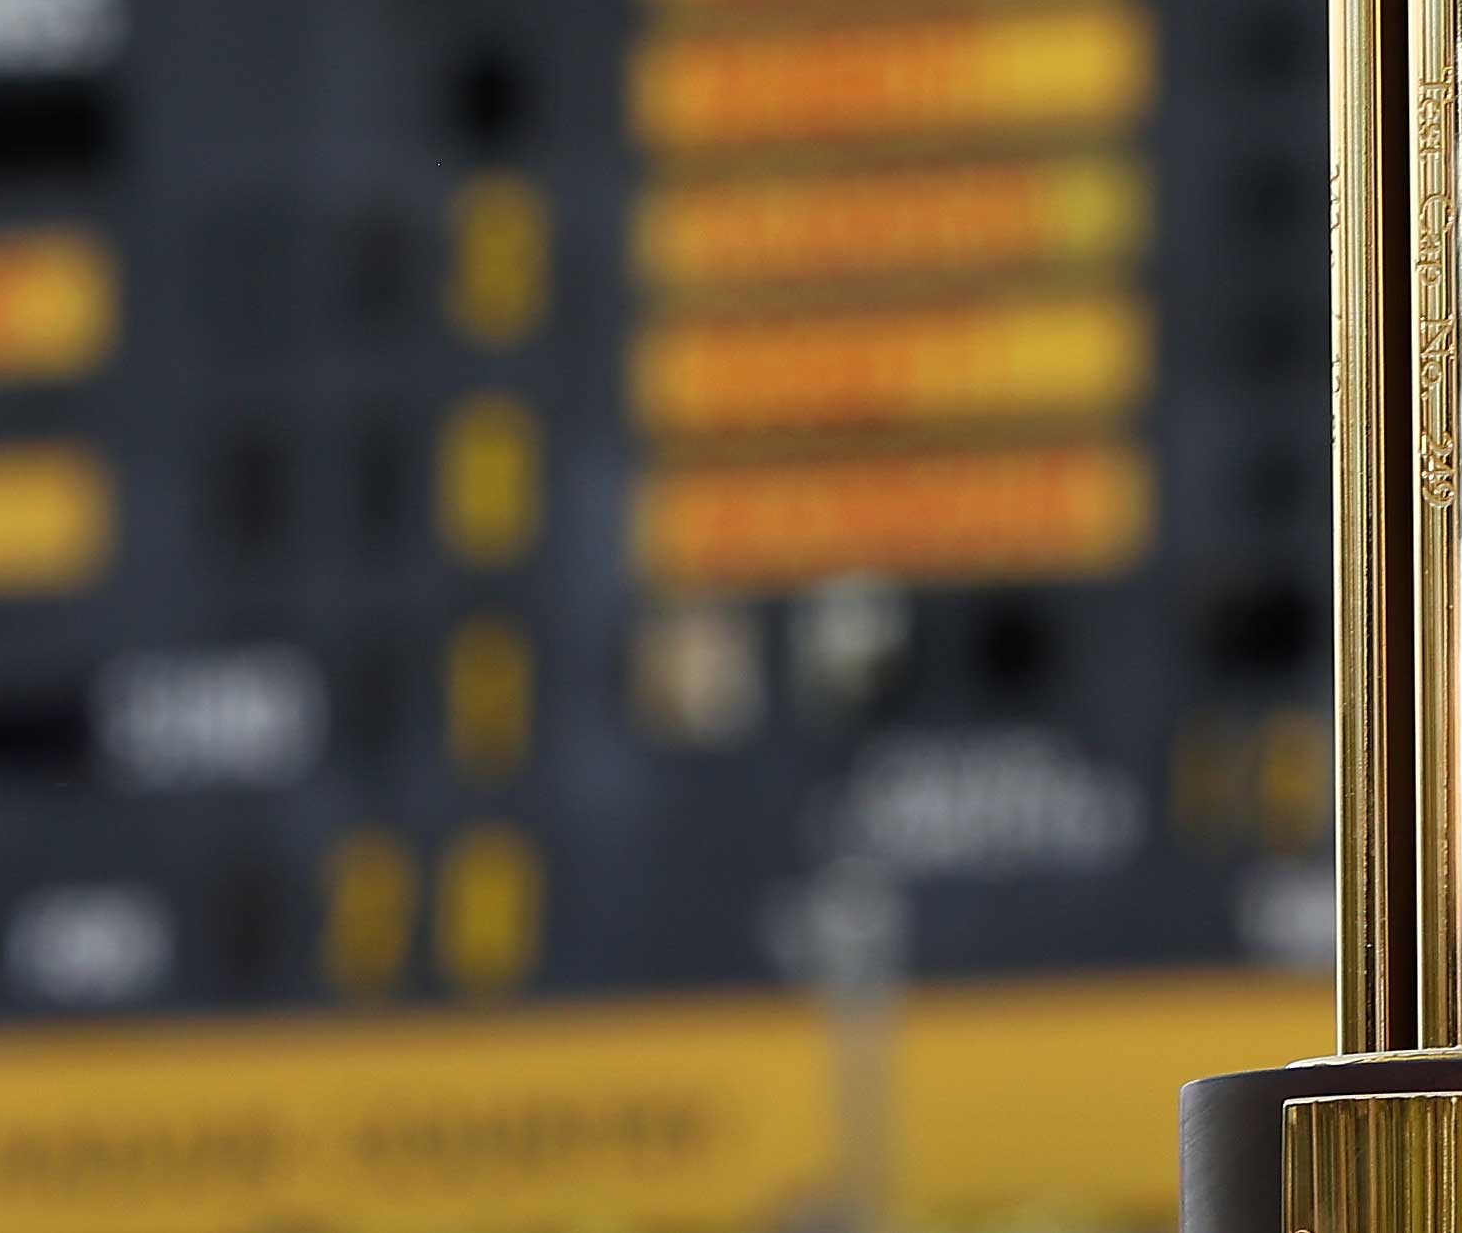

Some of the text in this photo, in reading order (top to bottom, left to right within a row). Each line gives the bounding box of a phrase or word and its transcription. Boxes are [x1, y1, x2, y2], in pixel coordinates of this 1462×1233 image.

[1415, 66, 1456, 511] Test Cap No. 249
